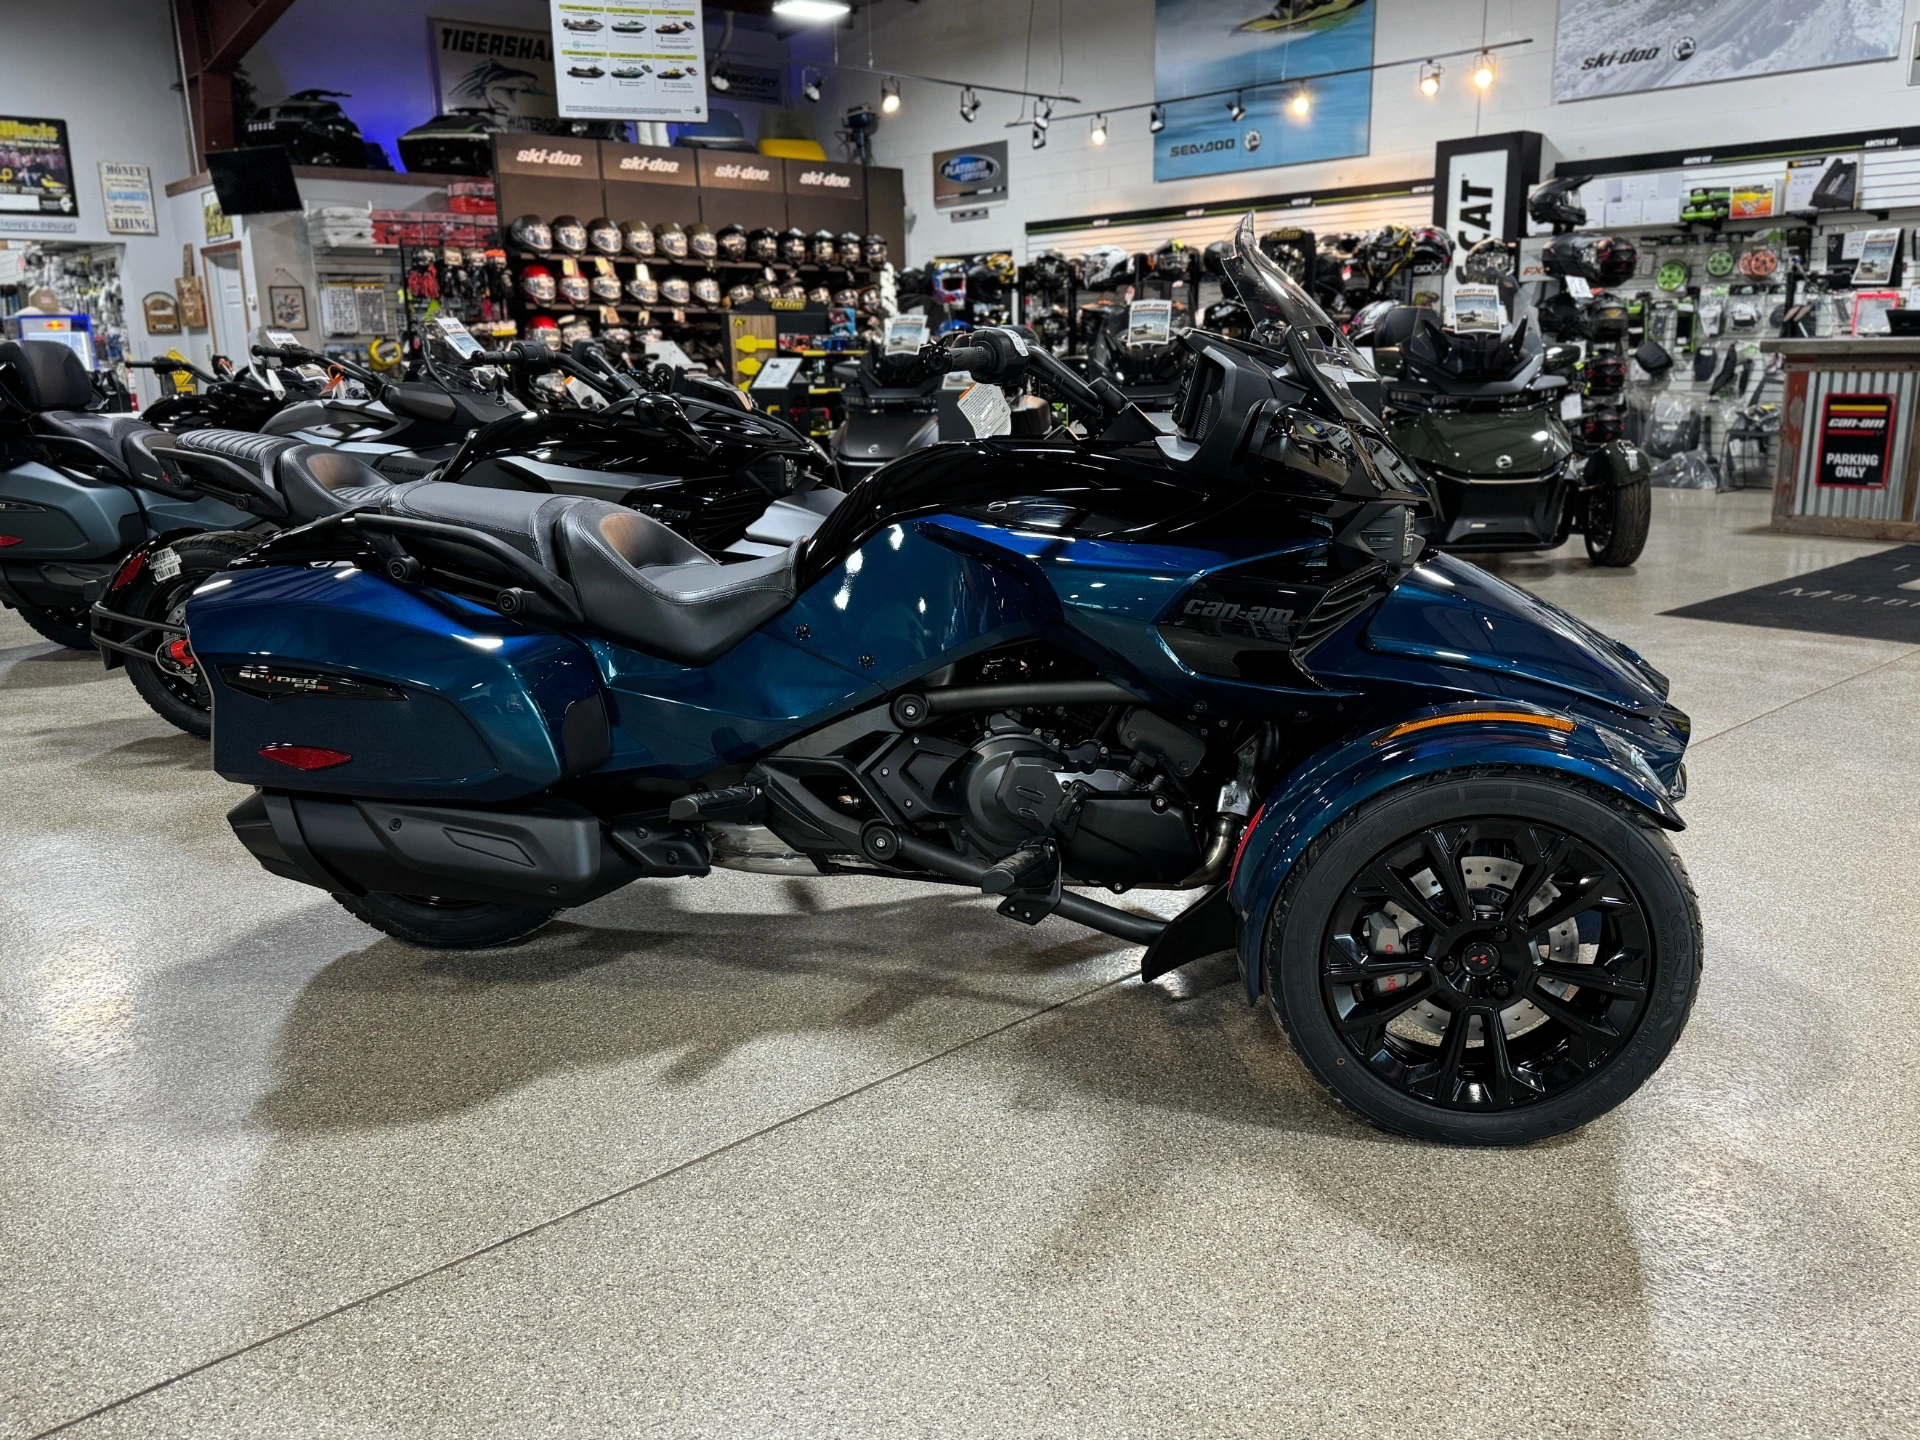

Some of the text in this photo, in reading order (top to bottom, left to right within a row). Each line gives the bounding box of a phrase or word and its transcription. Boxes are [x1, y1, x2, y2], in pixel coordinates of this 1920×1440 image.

[1581, 47, 1661, 70] ski-doo
[517, 149, 581, 166] ski-doo
[620, 156, 678, 172] ski-doo
[106, 165, 141, 176] MONEY
[715, 164, 769, 181] ski-doo
[800, 171, 850, 188] ski-doo
[114, 217, 150, 229] THING
[1828, 418, 1886, 428] can-am
[1826, 453, 1879, 466] PARKING
[1835, 466, 1867, 478] ONLY
[1183, 599, 1295, 624] can-am
[239, 671, 318, 685] SPYDER
